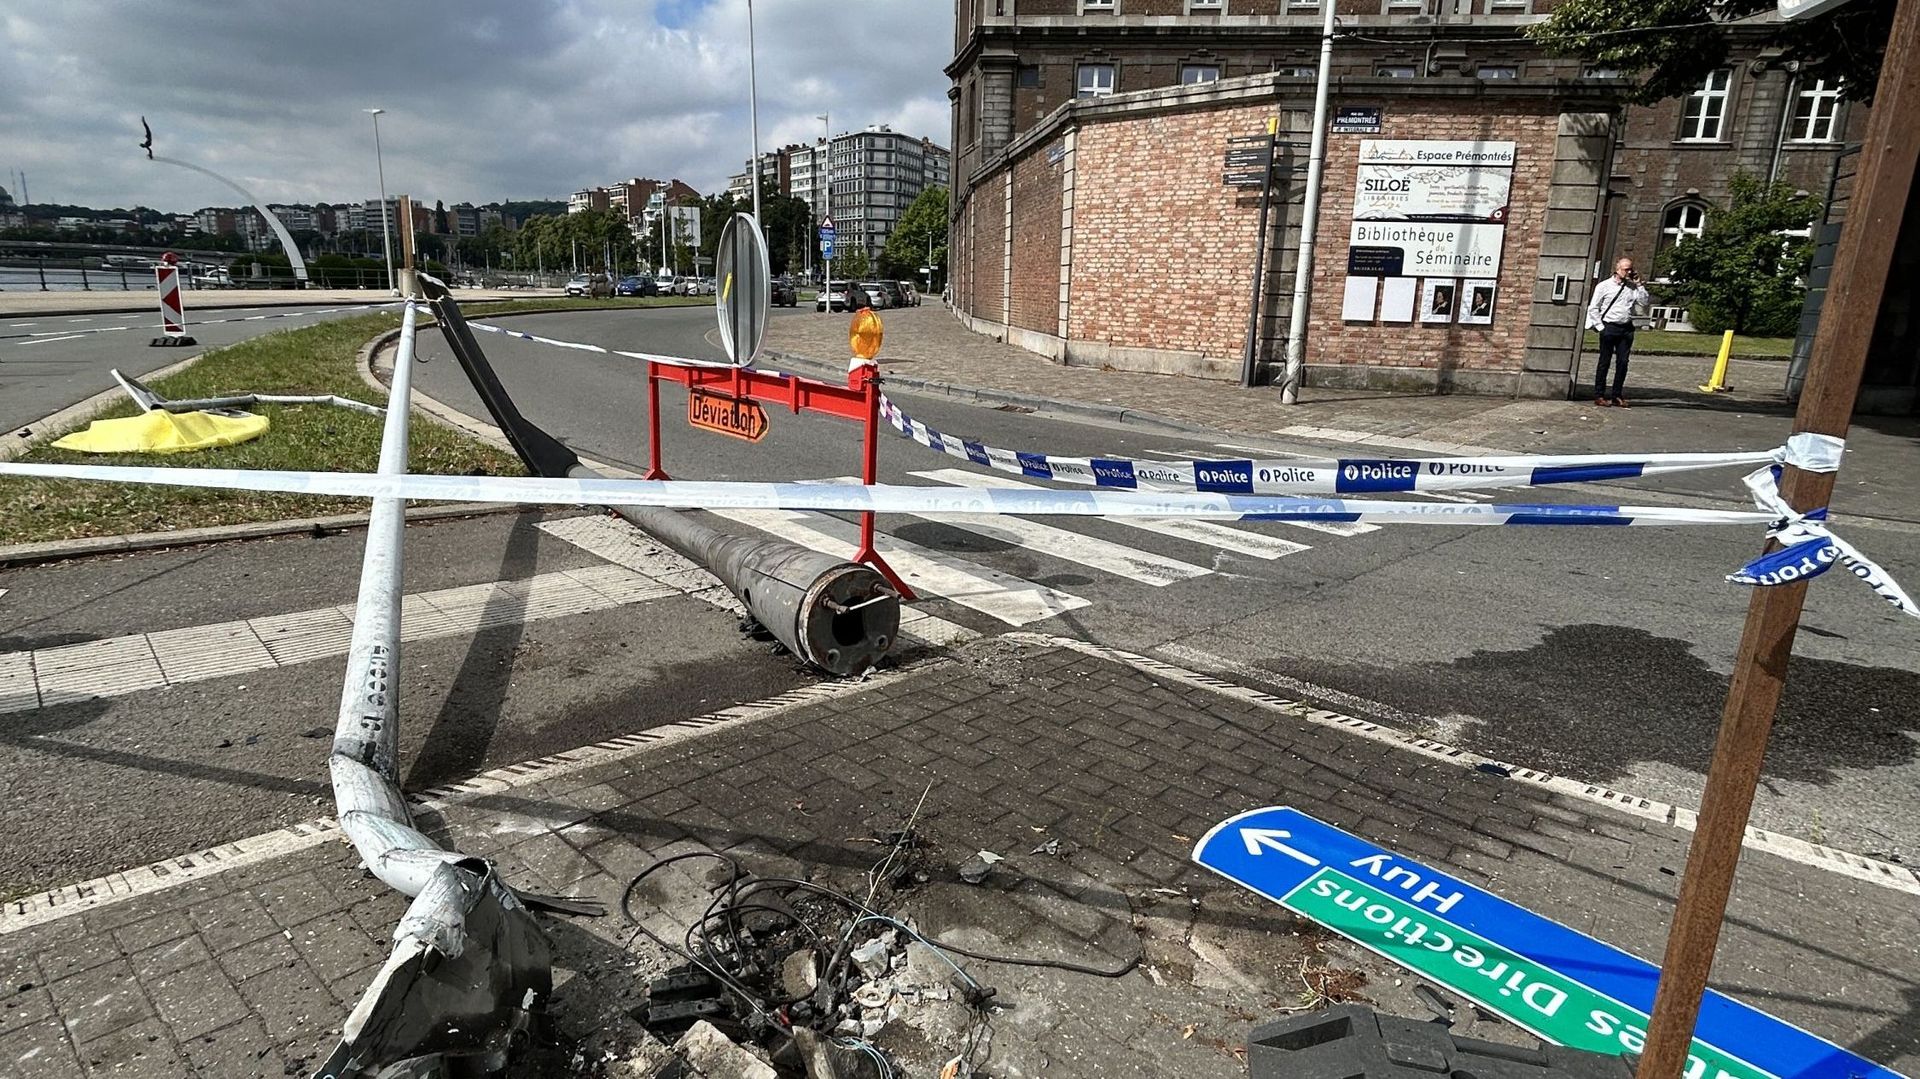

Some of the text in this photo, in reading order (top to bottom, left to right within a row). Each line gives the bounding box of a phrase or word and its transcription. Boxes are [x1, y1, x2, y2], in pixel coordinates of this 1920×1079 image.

[1336, 116, 1377, 124] PRÉMONTRÉS
[1417, 150, 1512, 161] Espace Prémontrés
[1365, 177, 1411, 192] SILOË
[1357, 227, 1455, 246] Bibliothèque
[824, 241, 832, 251] P
[1435, 244, 1446, 252] du
[1416, 250, 1492, 266] Séminaire
[1149, 469, 1180, 482] Police
[1211, 469, 1249, 484] Police
[1273, 468, 1315, 483] Police
[1361, 462, 1411, 480] Police
[1350, 854, 1464, 913] Huy
[1310, 878, 1568, 1017] Directions
